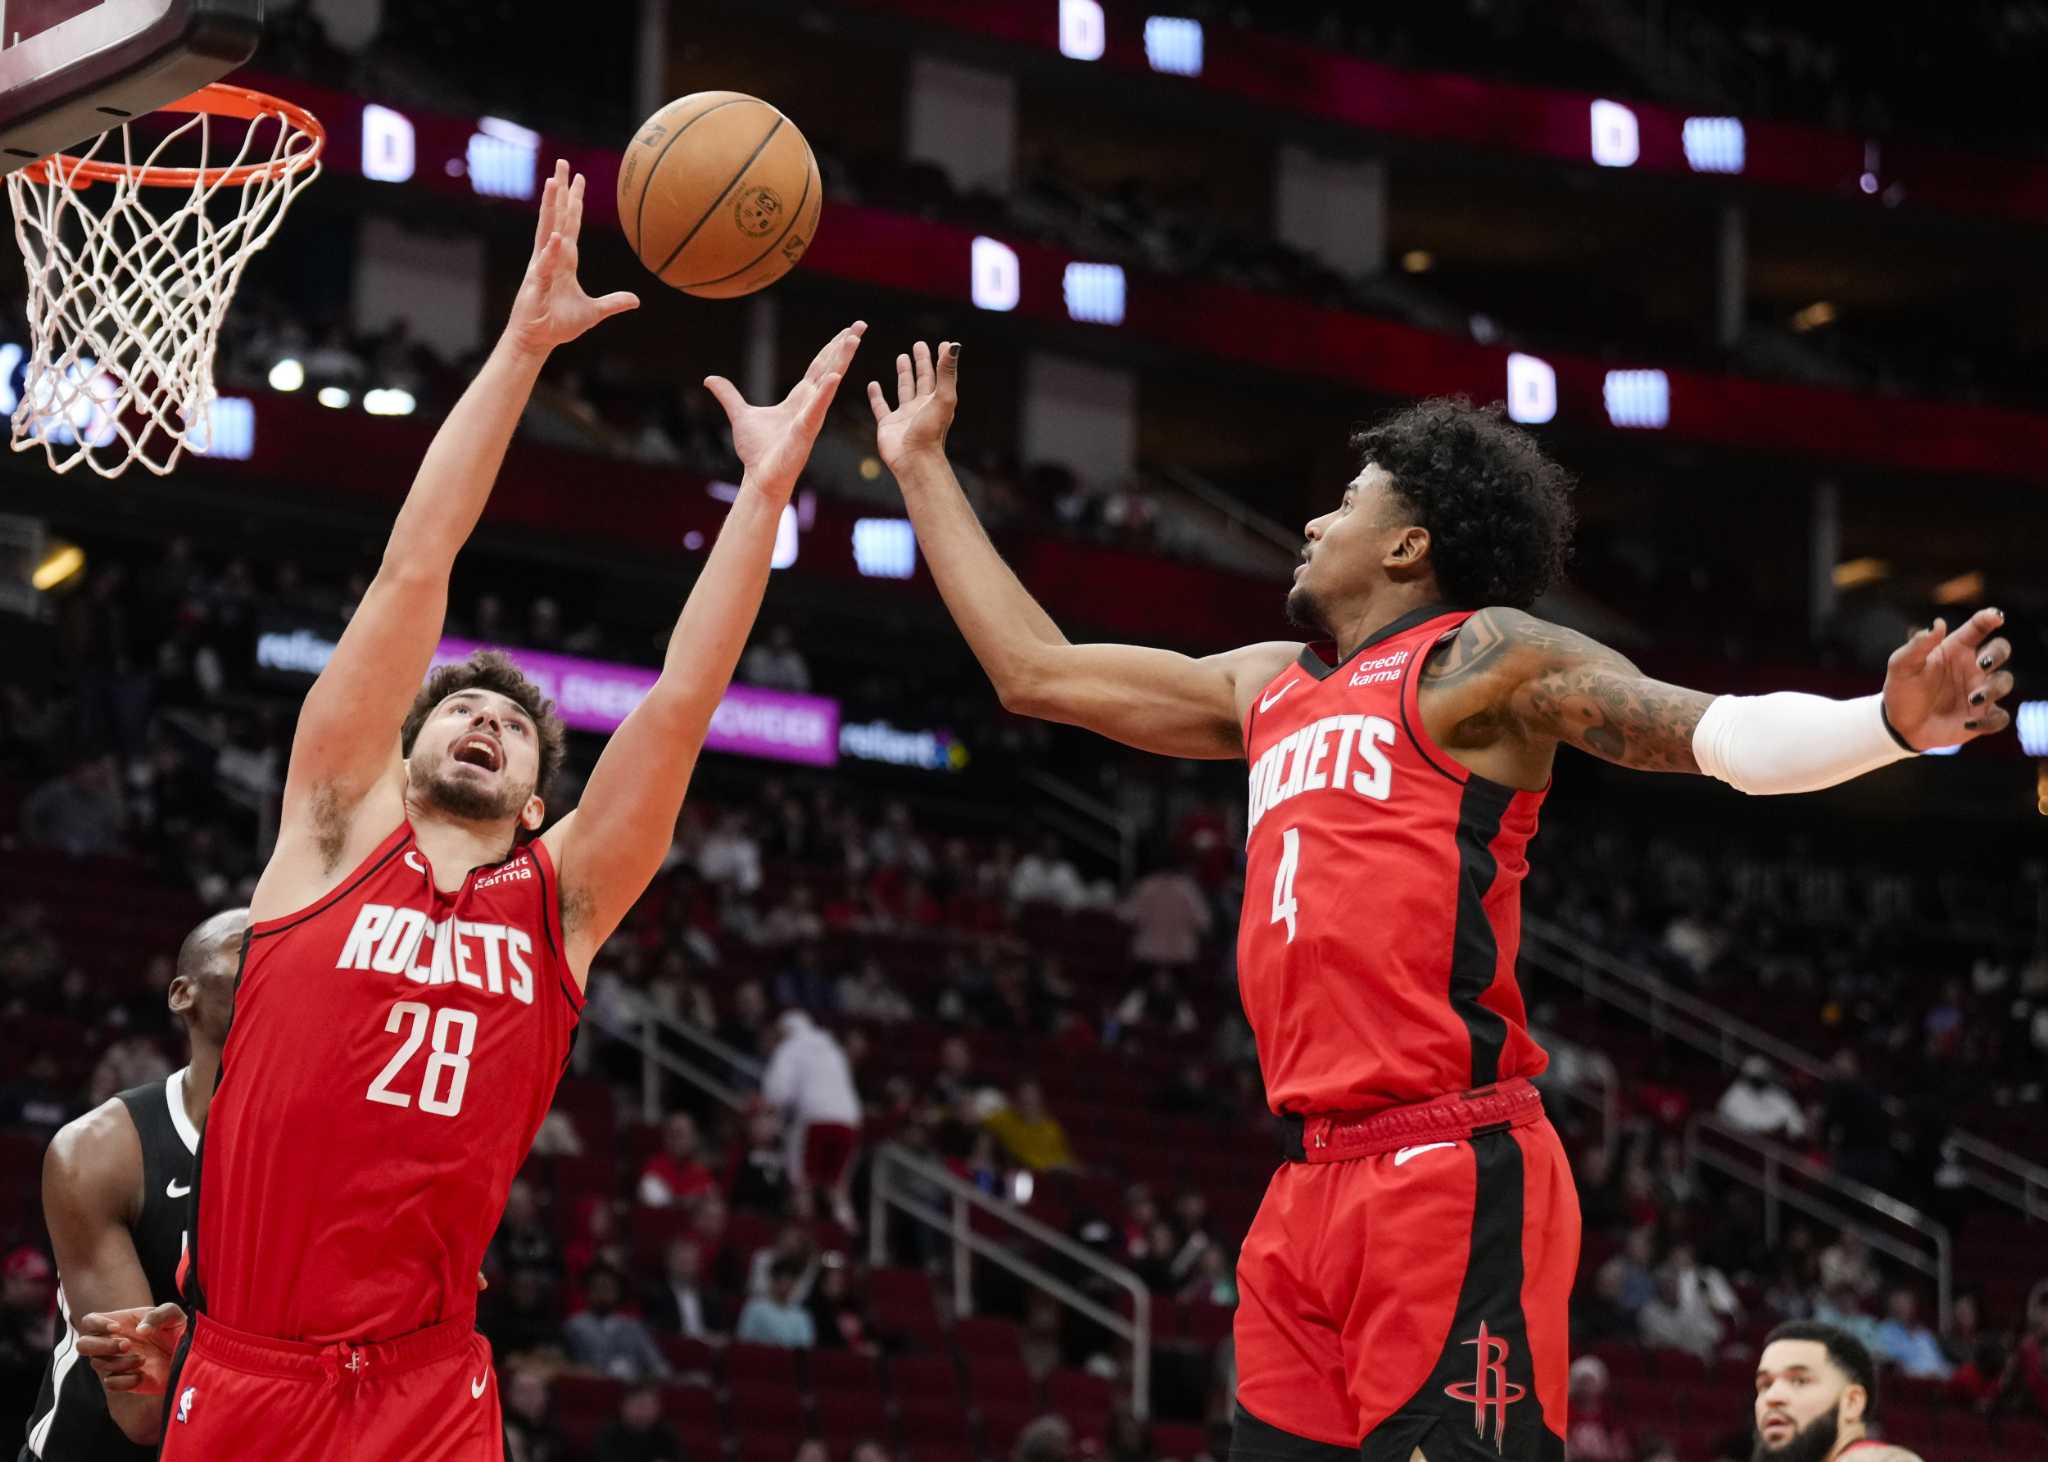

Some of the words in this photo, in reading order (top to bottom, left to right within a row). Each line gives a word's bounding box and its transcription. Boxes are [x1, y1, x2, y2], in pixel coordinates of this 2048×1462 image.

[1349, 669, 1400, 687] karma
[1360, 651, 1408, 671] credit
[1271, 828, 1299, 944] 4
[335, 903, 535, 1005] ROCKETS
[366, 1001, 478, 1117] 28
